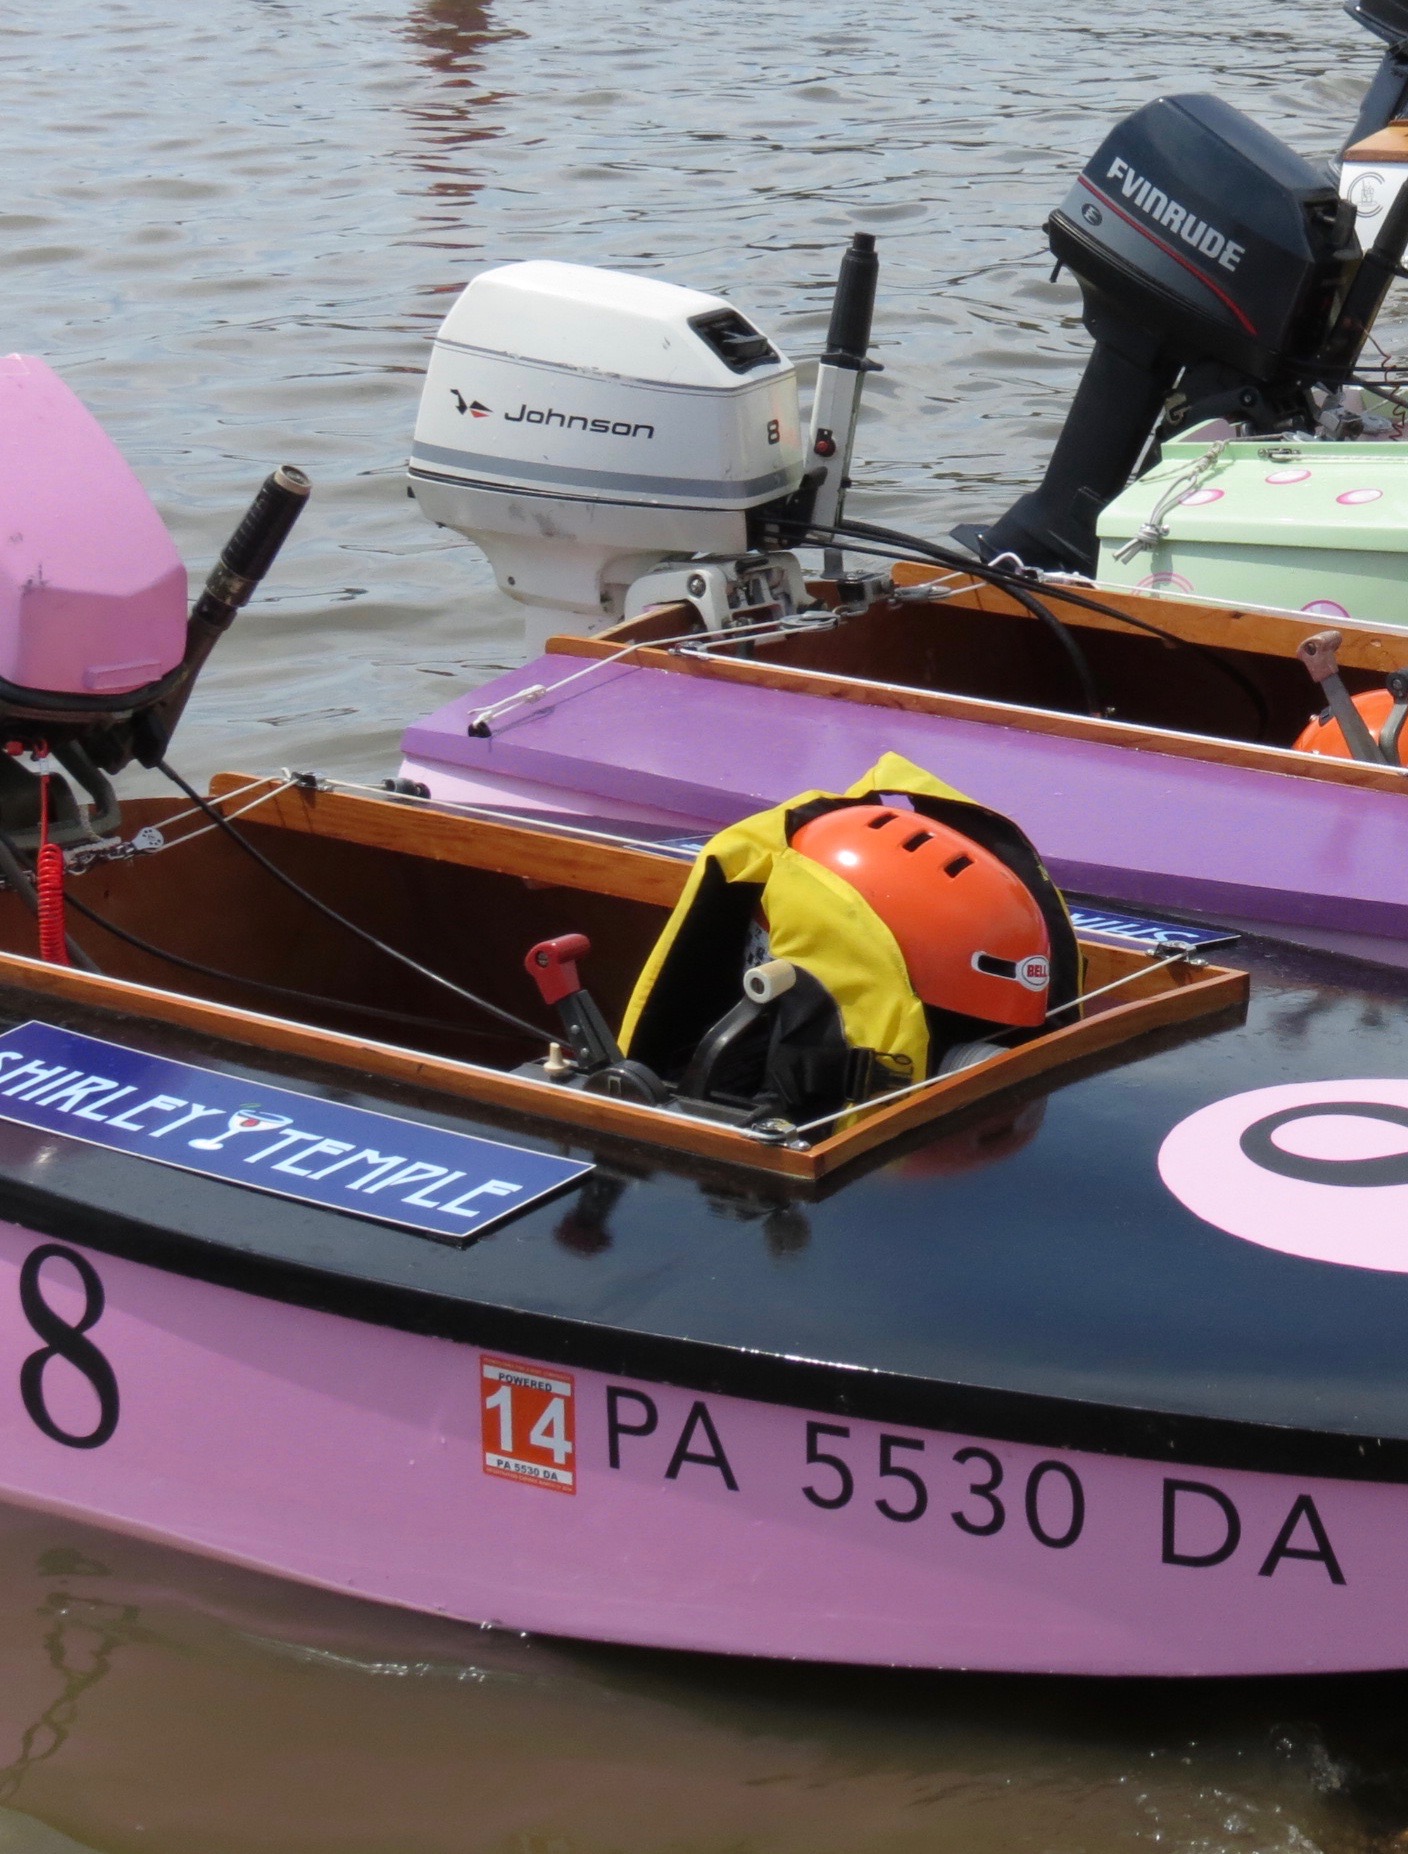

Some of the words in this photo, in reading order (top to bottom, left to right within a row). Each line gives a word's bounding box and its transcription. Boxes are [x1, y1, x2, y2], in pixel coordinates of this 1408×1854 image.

[504, 403, 655, 440] Johnson
[766, 418, 781, 445] 8
[1026, 963, 1048, 978] BELL
[243, 1128, 524, 1218] TEMPLE
[19, 1243, 120, 1449] 8
[498, 1372, 553, 1392] POWERED
[486, 1385, 573, 1465] 14
[496, 1458, 511, 1470] PA
[514, 1460, 540, 1478] 5530
[543, 1469, 559, 1480] DA
[605, 1384, 740, 1491] PA
[801, 1422, 1086, 1549] 5530
[1160, 1476, 1348, 1586] DA
